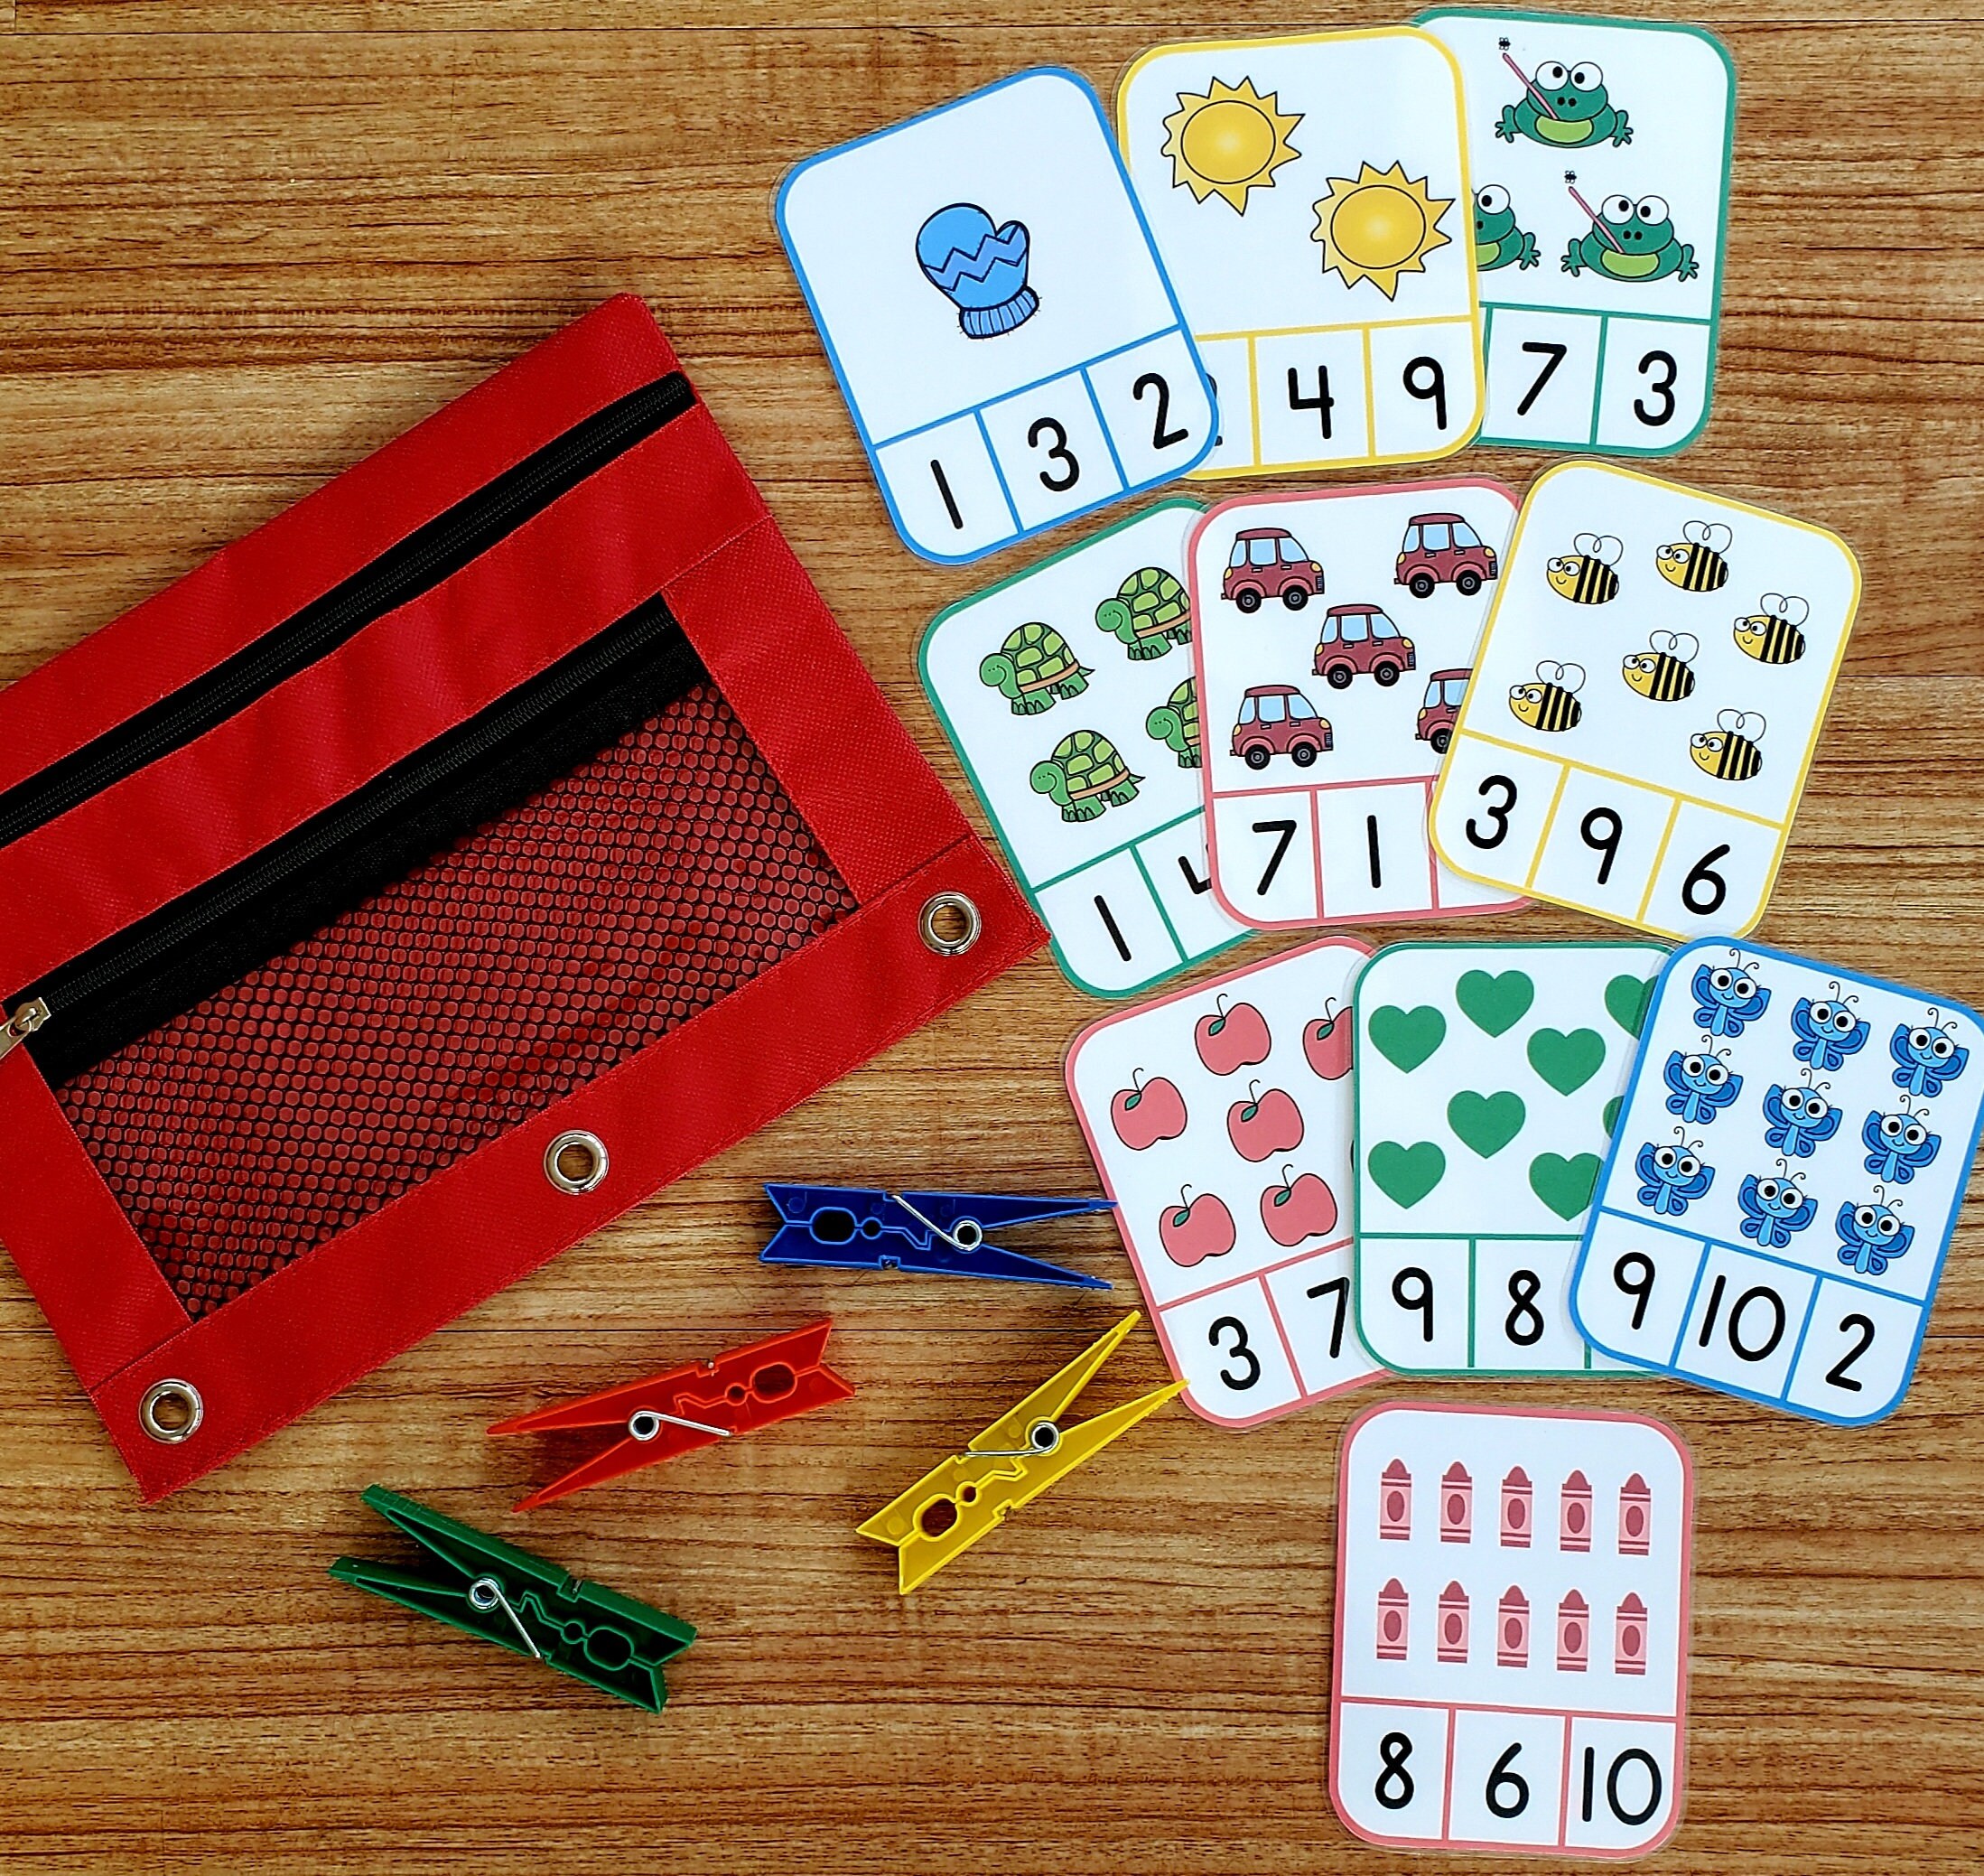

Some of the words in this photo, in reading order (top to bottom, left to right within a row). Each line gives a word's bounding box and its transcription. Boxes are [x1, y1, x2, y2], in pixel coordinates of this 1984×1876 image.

[1287, 364, 1336, 441] 4
[1402, 355, 1448, 432] 9
[1516, 341, 1569, 417] 7
[1633, 349, 1678, 428] 3
[929, 458, 964, 531] 1
[1027, 415, 1081, 493] 3
[1132, 371, 1190, 451] 2
[1251, 818, 1298, 897] 7
[1365, 814, 1383, 890] 1
[1465, 773, 1518, 851] 3
[1579, 806, 1624, 886] 9
[1681, 843, 1731, 917] 6
[1093, 893, 1132, 963] 1
[1207, 1315, 1262, 1392] 3
[1305, 1275, 1351, 1360] 7
[1391, 1265, 1434, 1343] 9
[1504, 1268, 1545, 1347] 8
[1612, 1251, 1656, 1331] 9
[1698, 1274, 1787, 1363] 10
[1825, 1312, 1876, 1393] 2
[1374, 1731, 1415, 1811] 8
[1485, 1741, 1531, 1820] 6
[1581, 1745, 1663, 1827] 10
